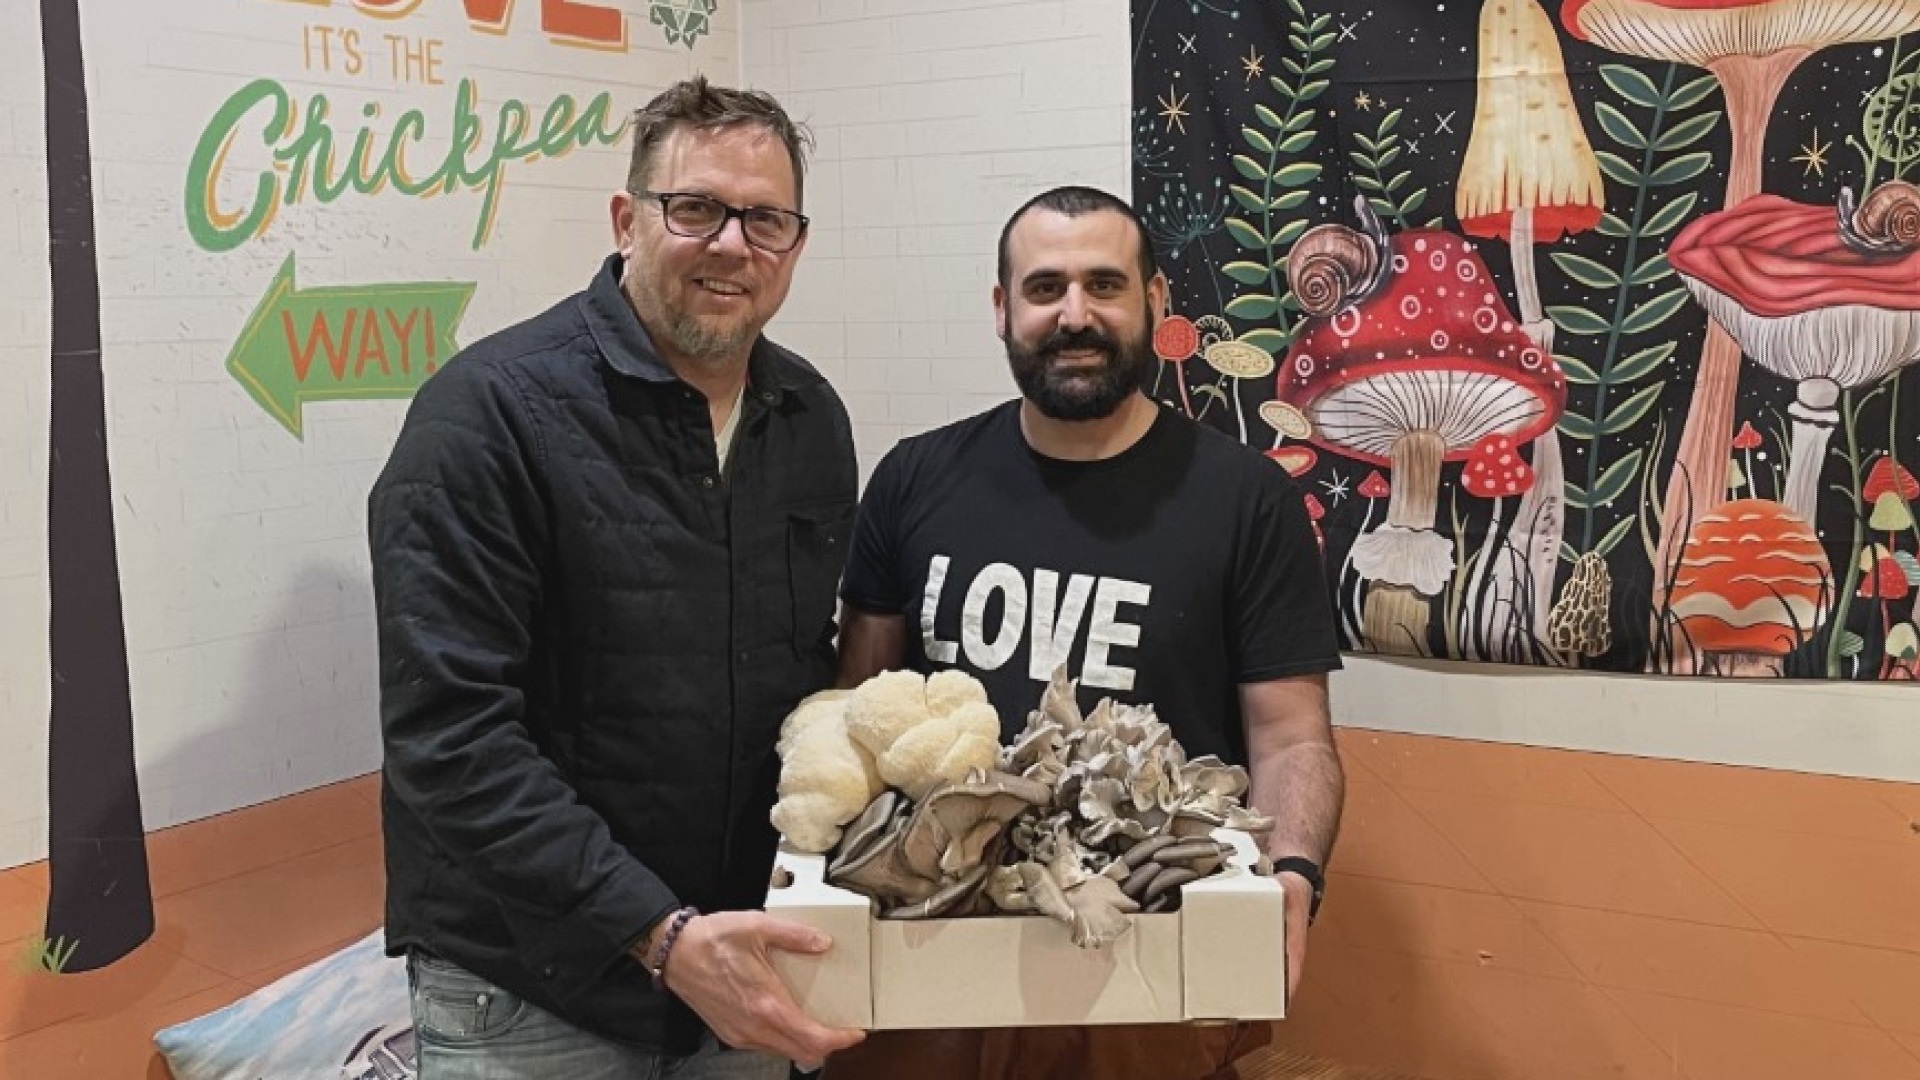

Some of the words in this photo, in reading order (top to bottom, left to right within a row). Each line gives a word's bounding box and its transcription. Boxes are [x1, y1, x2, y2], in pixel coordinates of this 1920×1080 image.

[303, 25, 363, 76] IT'S
[383, 33, 444, 86] THE
[184, 78, 627, 252] Chickpea
[281, 306, 436, 383] WAY!
[920, 554, 1152, 690] LOVE
